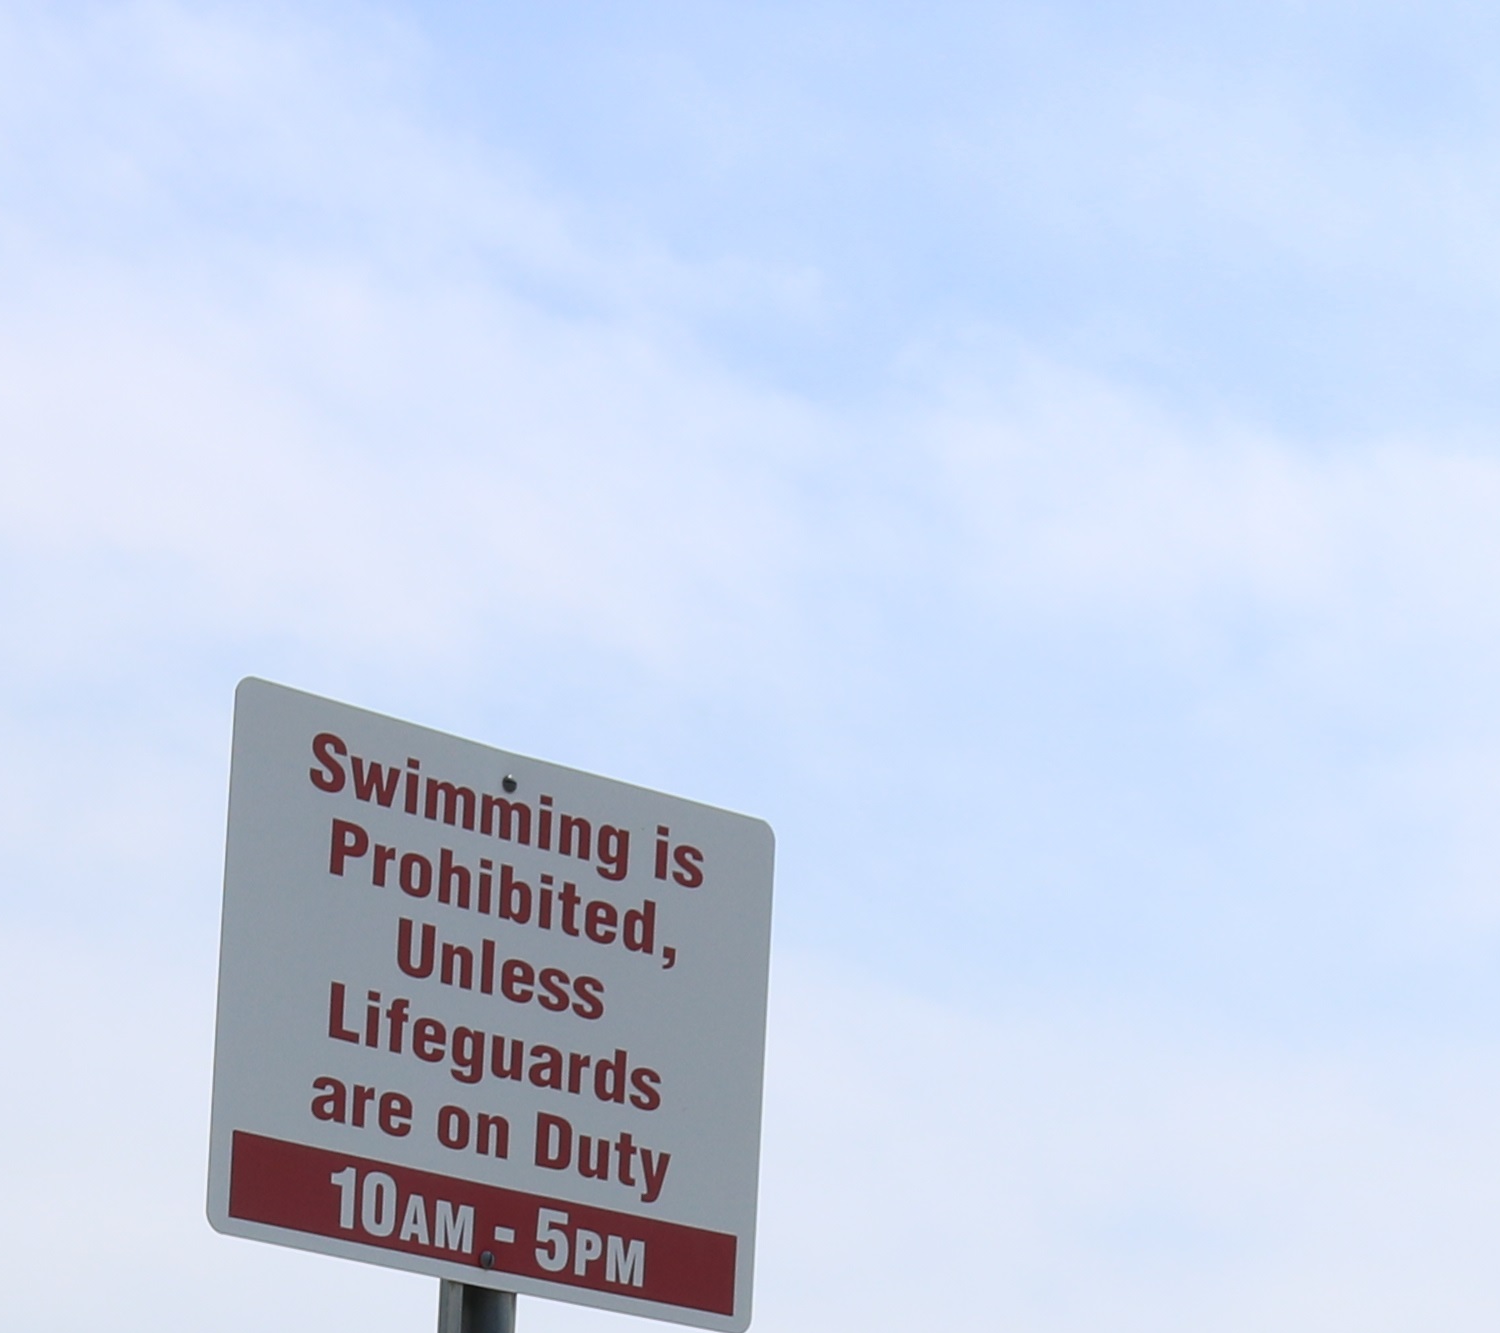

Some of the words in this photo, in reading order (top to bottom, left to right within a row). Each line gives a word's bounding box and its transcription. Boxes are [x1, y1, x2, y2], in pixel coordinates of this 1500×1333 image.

[309, 732, 630, 881] Swimming
[655, 825, 704, 888] is
[330, 819, 677, 969] Prohibited,
[397, 917, 604, 1020] Unless
[329, 981, 662, 1111] Lifeguards
[311, 1075, 413, 1137] are
[438, 1104, 510, 1159] on
[535, 1112, 671, 1203] Duty
[330, 1166, 475, 1255] 10AM
[493, 1225, 515, 1244] -
[535, 1207, 646, 1288] 5PM
